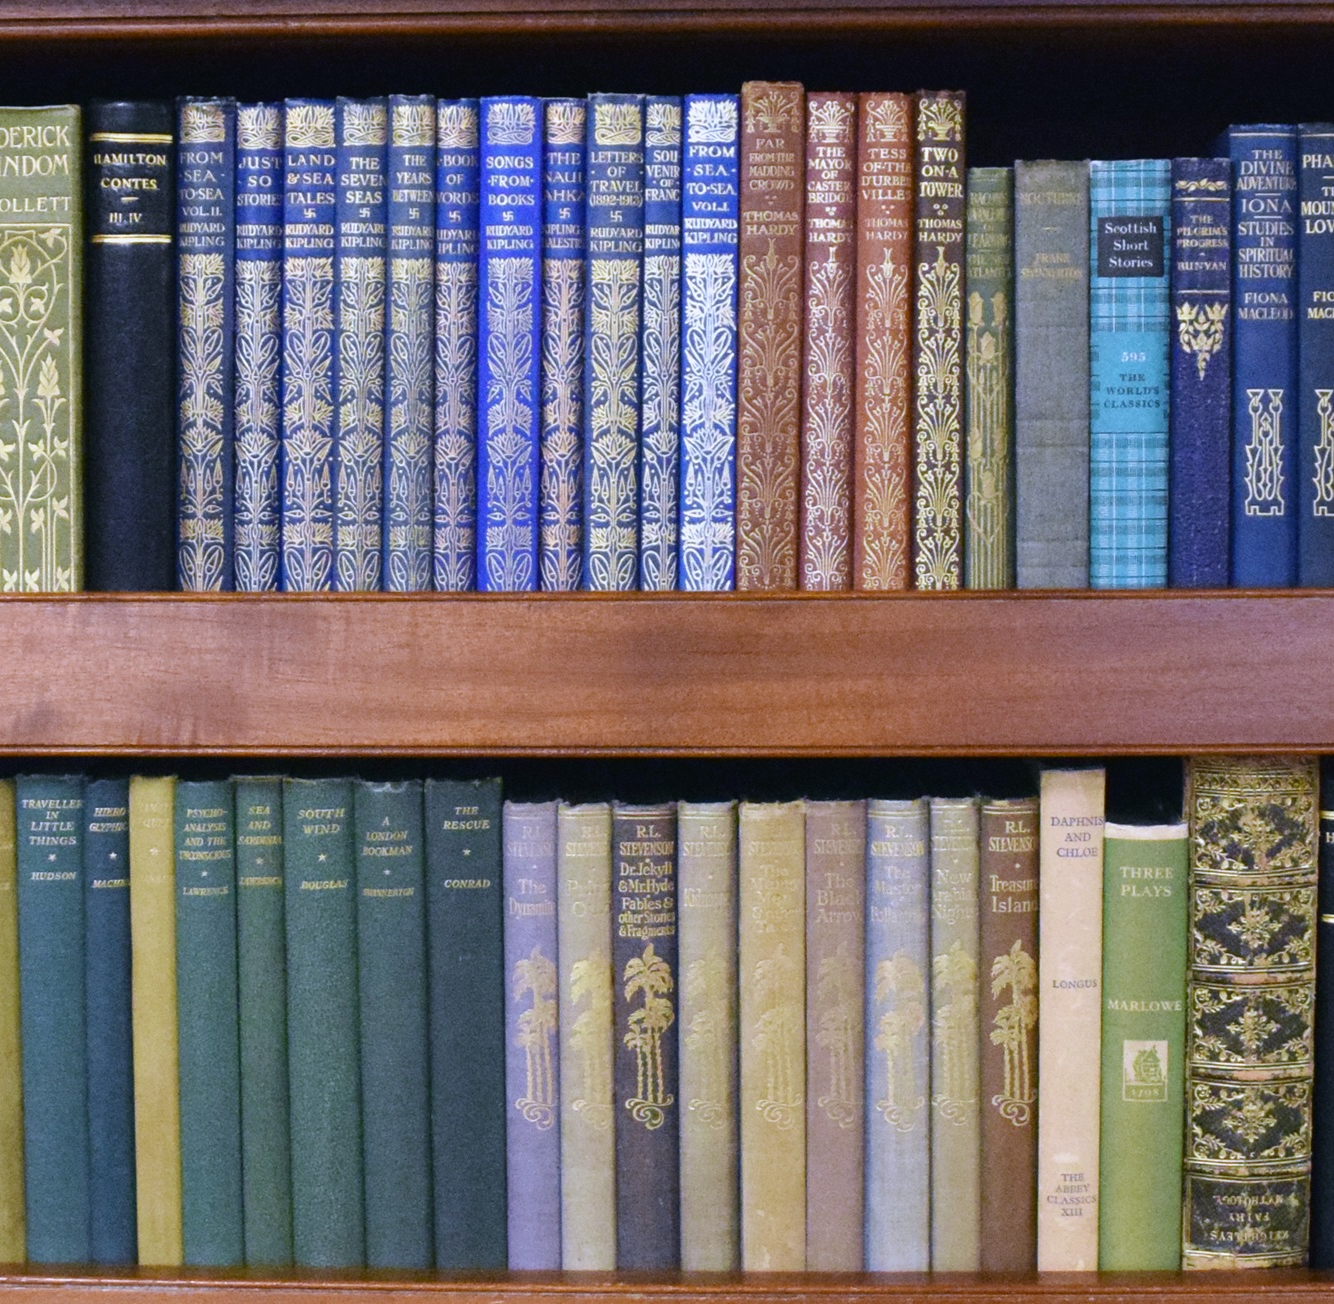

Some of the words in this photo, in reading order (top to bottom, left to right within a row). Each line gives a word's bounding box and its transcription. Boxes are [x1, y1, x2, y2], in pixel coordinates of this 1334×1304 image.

[756, 139, 785, 148] FAR
[689, 147, 735, 157] FROM
[817, 147, 845, 157] THE
[868, 148, 906, 159] TESS
[922, 147, 958, 162] TWO
[1252, 149, 1283, 159] THE
[180, 152, 223, 164] FROM
[288, 154, 335, 167] LAND
[350, 157, 380, 169] THE
[403, 155, 426, 166] THE
[486, 156, 533, 169] SONGS
[1240, 161, 1294, 176] DIVINE
[822, 170, 838, 180] OF
[591, 180, 642, 192] TRAVEL
[920, 182, 962, 198] TOWER
[287, 192, 335, 205] TALES
[346, 191, 382, 204] SEAS
[489, 194, 534, 206] BOOKS
[1242, 199, 1293, 213] IONA
[744, 211, 798, 222] THOMAS
[1190, 215, 1213, 224] THE
[918, 219, 962, 229] THOMAS
[1105, 222, 1157, 235] Scottish
[1238, 221, 1294, 236] STUDIES
[747, 225, 797, 236] HARDY
[919, 232, 962, 242] HARDY
[1260, 237, 1275, 247] IN
[1113, 239, 1149, 252] Short
[1177, 238, 1229, 249] PROGRESS
[1109, 256, 1154, 268] Stories
[1178, 261, 1226, 272] BUNYAN
[1239, 264, 1293, 279] HISTORY
[1120, 352, 1146, 363] 595
[1119, 373, 1146, 383] THE
[1103, 398, 1161, 409] CLASSICS
[46, 811, 59, 819] IN
[248, 806, 271, 815] SEA
[298, 808, 346, 820] SOUTH
[454, 806, 479, 816] THE
[31, 822, 74, 831] LITTLE
[248, 820, 271, 830] AND
[382, 816, 391, 826] A
[443, 820, 490, 831] RESCUE
[1051, 816, 1105, 826] DAPHNIS
[303, 823, 341, 835] WIND
[636, 825, 661, 838] R.L.
[1005, 821, 1030, 834] R.L.
[29, 836, 77, 845] THINGS
[366, 831, 407, 841] LONDON
[1064, 833, 1091, 842] AND
[620, 842, 674, 856] STEVENSON
[1056, 848, 1098, 858] CHLOE
[31, 872, 77, 880] HUDSON
[1119, 866, 1175, 879] THREE
[300, 879, 348, 890] DOUGLAS
[444, 879, 490, 889] CONRAD
[824, 873, 855, 888] The
[519, 879, 546, 894] The
[1120, 885, 1172, 897] PLAYS
[622, 897, 662, 909] Fables
[1052, 979, 1097, 989] LONGUS
[1107, 1000, 1183, 1011] MARLOWE
[1060, 1173, 1084, 1182] THE
[1055, 1183, 1090, 1194] ABBEY
[1047, 1194, 1097, 1205] CLASSICS
[1061, 1208, 1082, 1217] XIII
